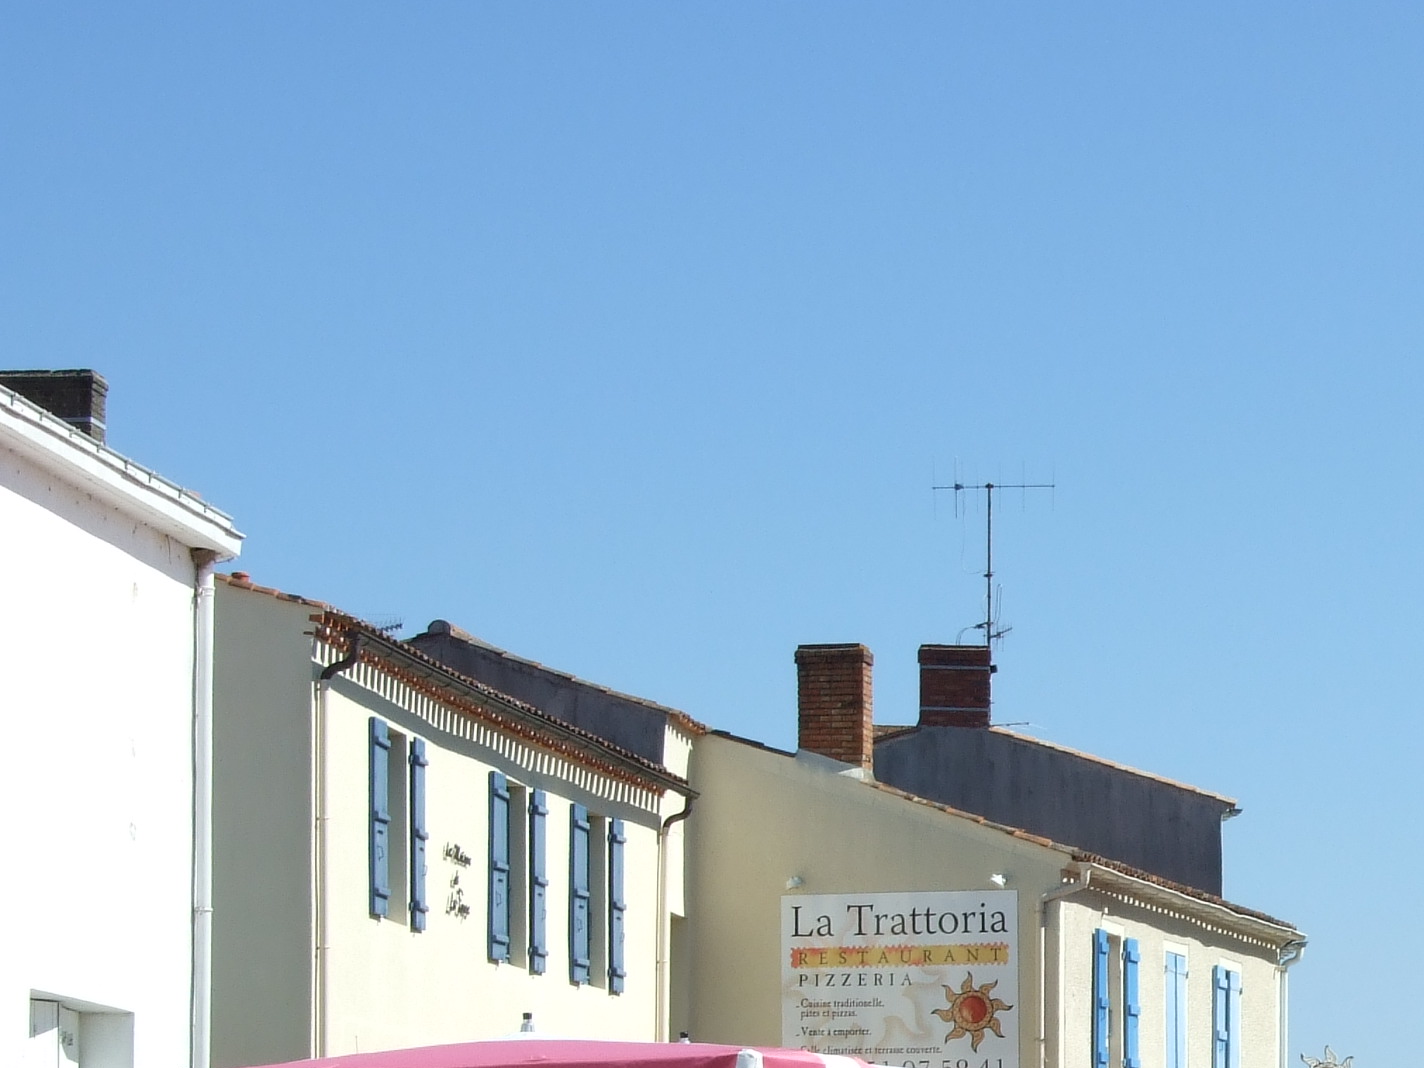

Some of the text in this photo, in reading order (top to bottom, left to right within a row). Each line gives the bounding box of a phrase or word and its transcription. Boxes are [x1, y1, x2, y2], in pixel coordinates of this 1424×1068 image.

[791, 902, 1008, 937] La Trattoria
[798, 947, 1003, 965] RESTAURANT
[799, 973, 913, 987] PIZZERIA
